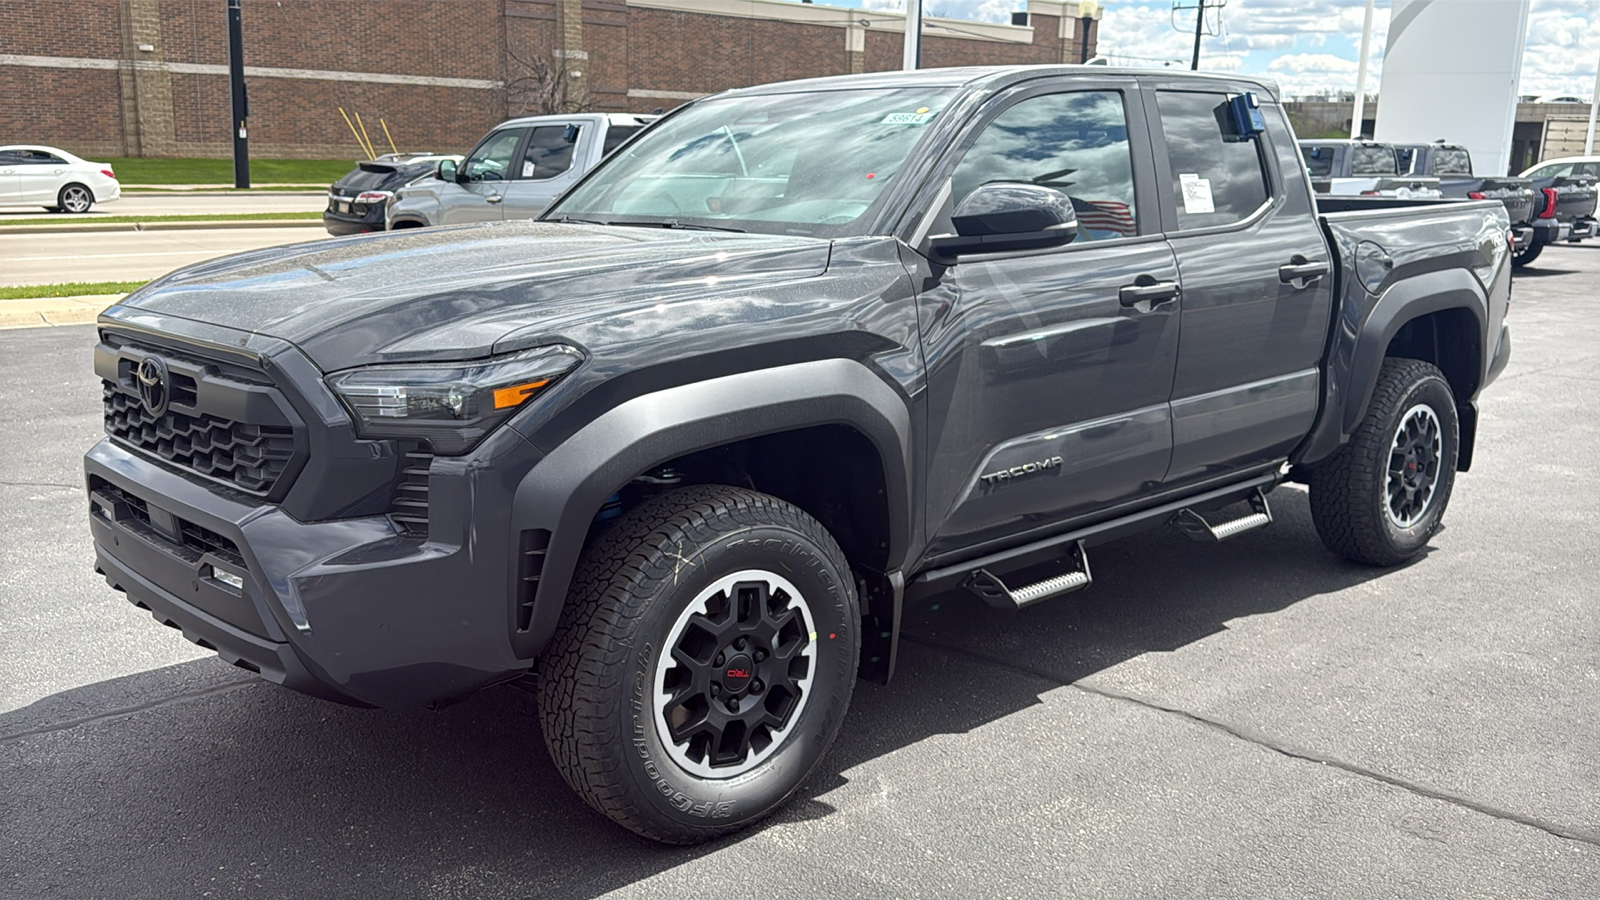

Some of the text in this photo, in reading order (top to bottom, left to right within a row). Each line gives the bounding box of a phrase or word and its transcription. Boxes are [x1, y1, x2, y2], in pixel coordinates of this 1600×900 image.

[981, 455, 1064, 484] TACOMA
[727, 667, 750, 678] TRD
[629, 640, 737, 819] BFGoodrich
